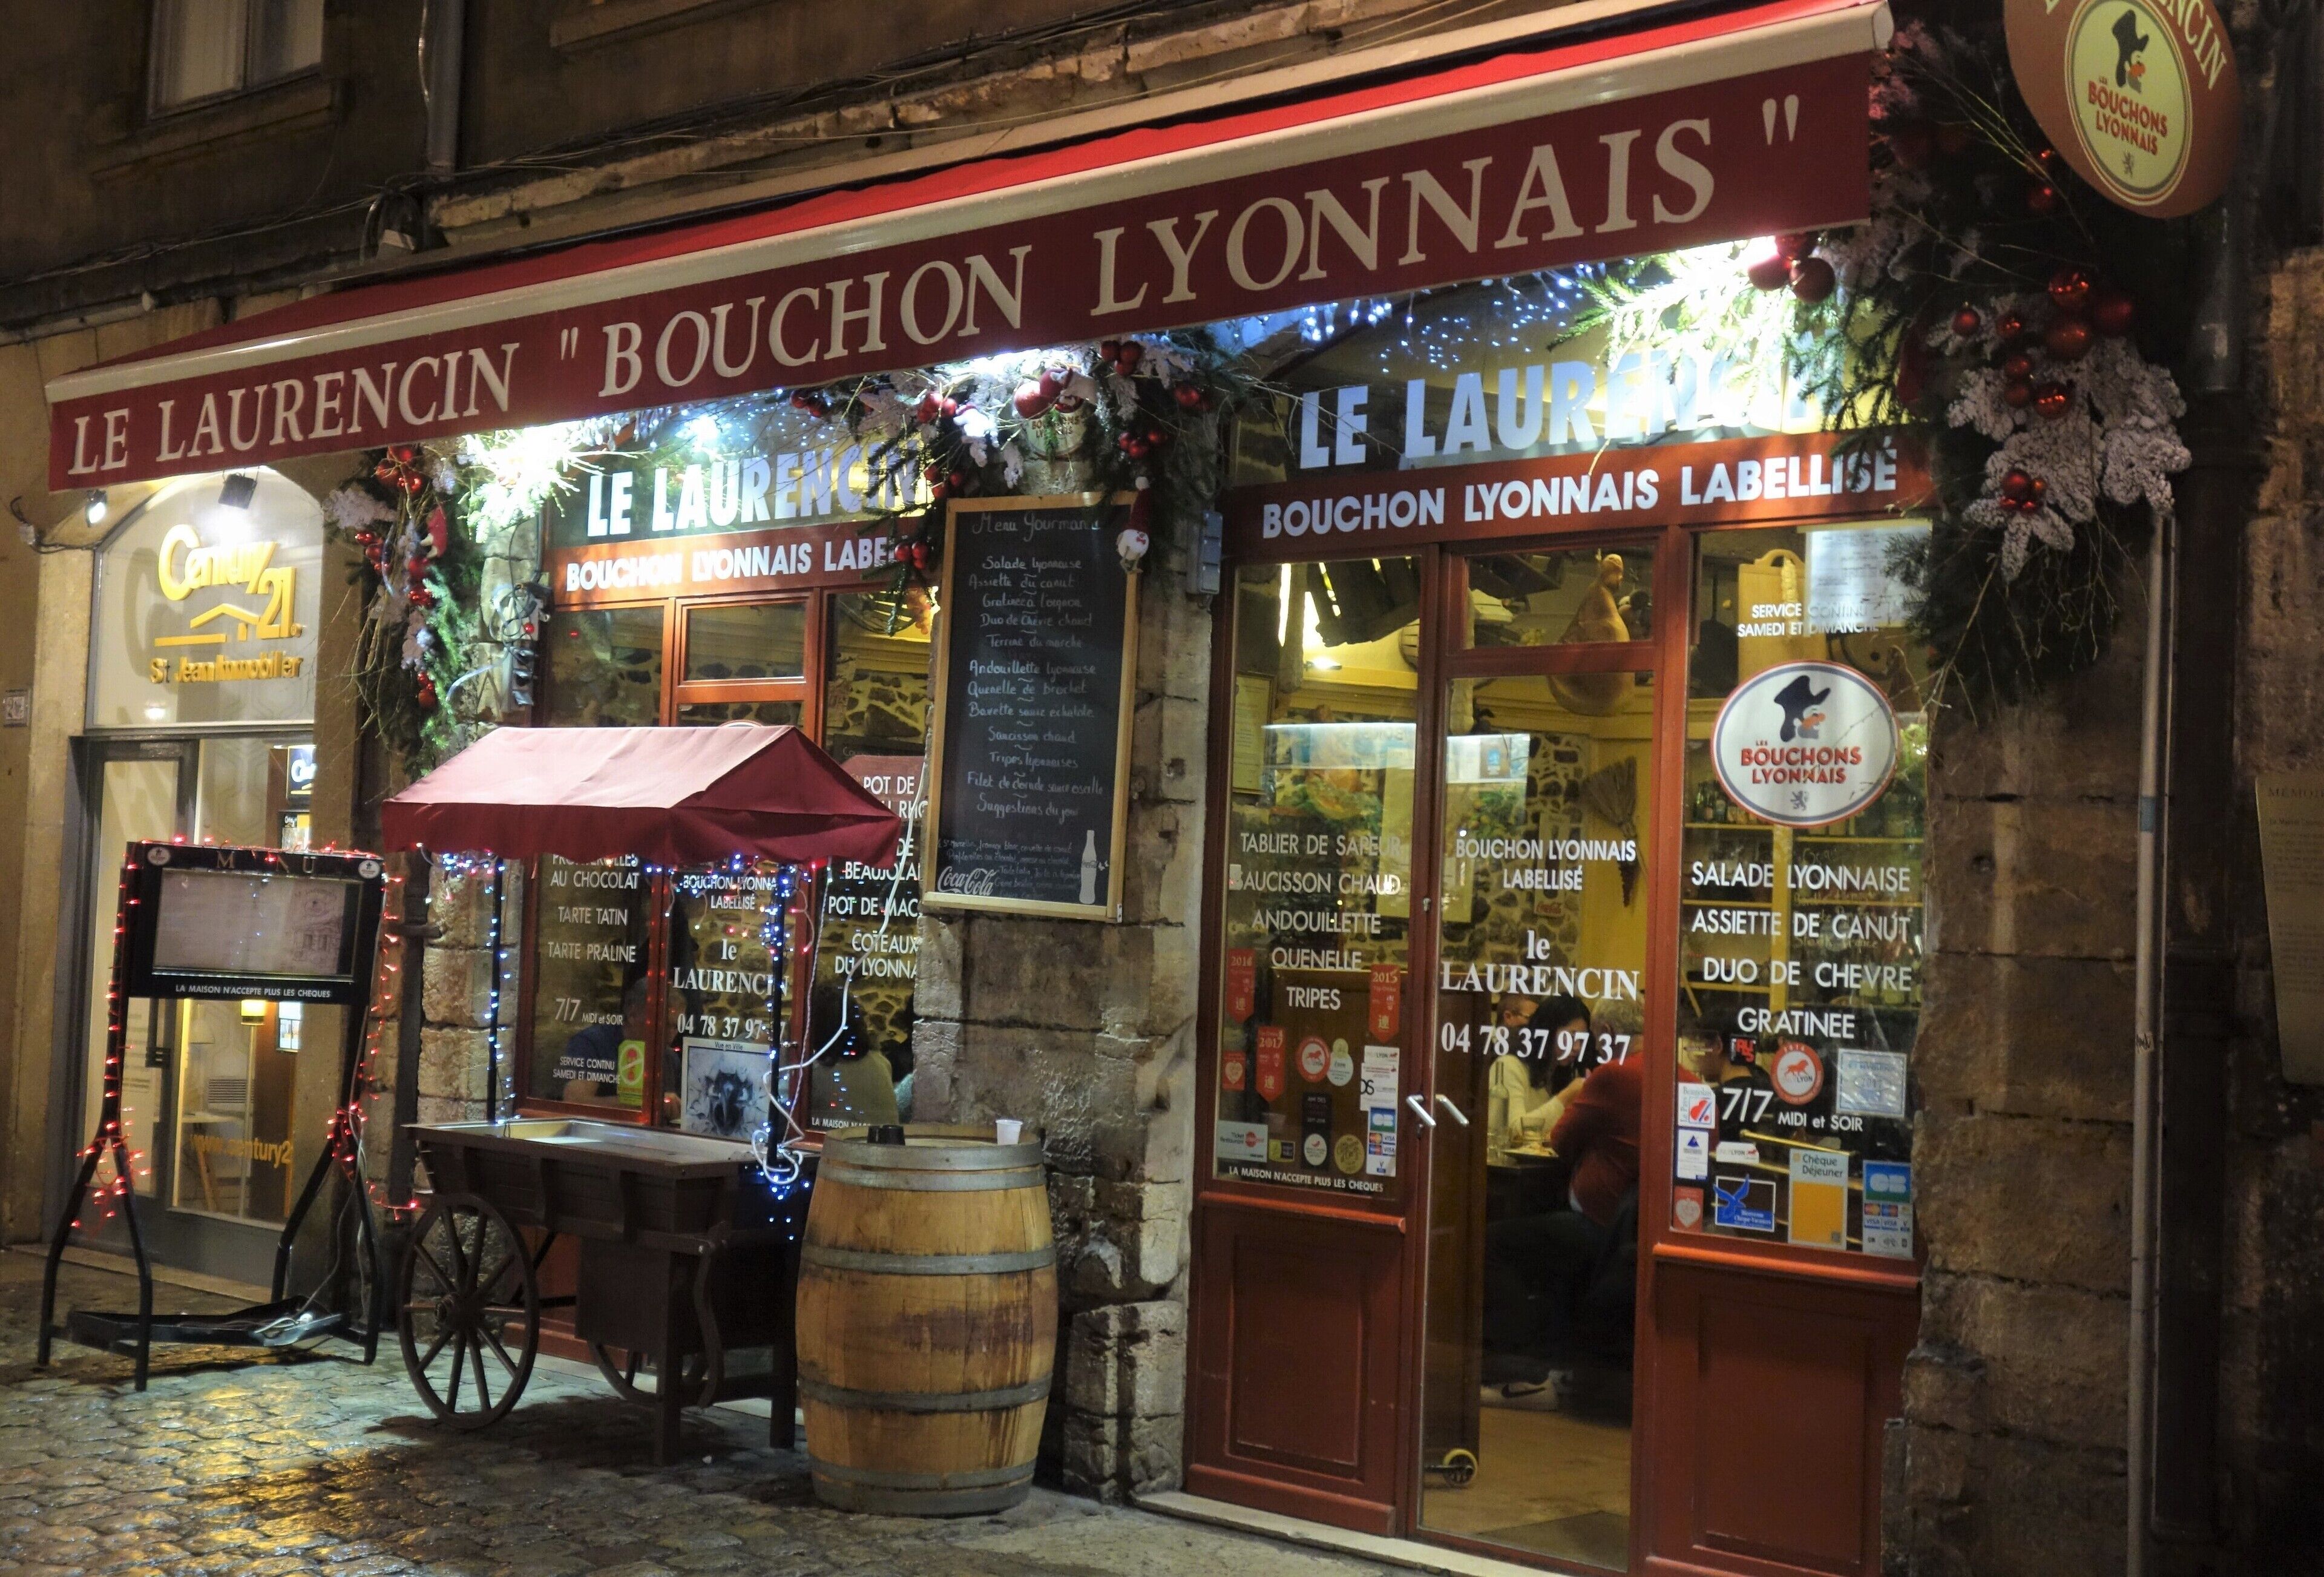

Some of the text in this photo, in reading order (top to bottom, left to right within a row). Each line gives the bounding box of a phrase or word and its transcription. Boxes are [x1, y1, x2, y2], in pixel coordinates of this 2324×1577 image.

[2089, 81, 2168, 138] BOUCHONS
[2096, 111, 2158, 156] LYONNAIS
[68, 117, 1715, 475] LE LAURENCIN BOUCHON LYONNAIS
[1299, 385, 1368, 469] LE
[587, 472, 632, 538] LE
[1263, 486, 1445, 539] BOUCHON
[1465, 469, 1659, 522] LYONNAIS
[972, 515, 1018, 534] Menu
[157, 524, 278, 602] Century
[566, 551, 682, 592] BOUCHON
[692, 544, 812, 582] LYONNAIS
[982, 556, 1026, 570] Salade
[969, 574, 1013, 590] Assiette
[245, 567, 298, 639] 21
[1752, 603, 1802, 619] SERVICE
[979, 613, 1003, 627] Duo
[1006, 613, 1018, 626] de
[1738, 622, 1785, 638] SAMEDI
[1790, 621, 1804, 636] ET
[985, 634, 1023, 648] Terrine
[970, 659, 1040, 676] Andouillette
[968, 680, 1017, 697] Quenelle
[1023, 682, 1035, 694] de
[968, 702, 1014, 718] Bavette
[988, 726, 1077, 743] Saucisson chaud
[989, 752, 1023, 768] Tripes
[1741, 746, 1862, 767] BOUCHONS
[864, 776, 915, 795] POT DE
[967, 771, 994, 788] Filet
[999, 775, 1011, 789] de
[1752, 767, 1846, 785] LYONNAIS
[977, 792, 1043, 818] Suggestions
[1045, 801, 1060, 816] du
[896, 838, 914, 857] DE
[1241, 832, 1401, 857] TABLIER DE SAPEUR
[1456, 838, 1636, 862] BOUCHON LYONNAIS
[551, 871, 639, 889] AU CHOCOLAT
[683, 874, 778, 892] BOUCHON LYONNA
[938, 866, 999, 897] Coca-Cola
[1338, 874, 1400, 895] CHAUD
[1503, 864, 1583, 891] LABELLISÉ
[1691, 861, 1911, 892] SALADE LYONNAISE
[711, 893, 756, 910] LABELLISÉ
[829, 896, 919, 917] POT DE MAC
[558, 906, 628, 926] TARTE TATIN
[1252, 909, 1380, 934] ANDOUILLETTE
[1691, 909, 1911, 943] ASSIETTE DE CANUT
[548, 941, 637, 963] TARTE PRALINE
[721, 938, 738, 961] le
[1527, 930, 1550, 960] le
[835, 955, 917, 979] DU LYONNA
[1272, 947, 1362, 970] QUENELLE
[1440, 961, 1640, 1001] LAURENCIN
[1703, 957, 1912, 992] DUO DE CHEVRE
[188, 985, 220, 993] MAISON
[223, 986, 261, 996] N'ACCEPTE
[264, 987, 281, 996] PLUS
[283, 989, 295, 997] LES
[298, 989, 330, 998] CHEQUES
[1287, 986, 1341, 1010] TRIPES
[582, 1013, 598, 1024] MIDI
[599, 1015, 605, 1024] et
[606, 1014, 623, 1026] SOIR
[677, 1013, 763, 1039] 04 78 37 97
[1738, 1007, 1856, 1039] GRATINEE
[1441, 1022, 1630, 1065] 04 78 37 97 37
[560, 1056, 615, 1070] SERVICE CONTINU
[553, 1068, 621, 1084] SAMEDI ET DIMANCHE
[812, 1117, 819, 1126] LA
[822, 1119, 849, 1128] MAISON
[1777, 1112, 1807, 1127] MIDI
[1813, 1116, 1825, 1128] et
[1830, 1115, 1863, 1132] SOIR
[1802, 1153, 1838, 1167] Chèque
[1229, 1166, 1384, 1193] LA MAISON N'ACCEPTE PLUS LES CHEQUES
[1802, 1164, 1843, 1179] Déjeuner
